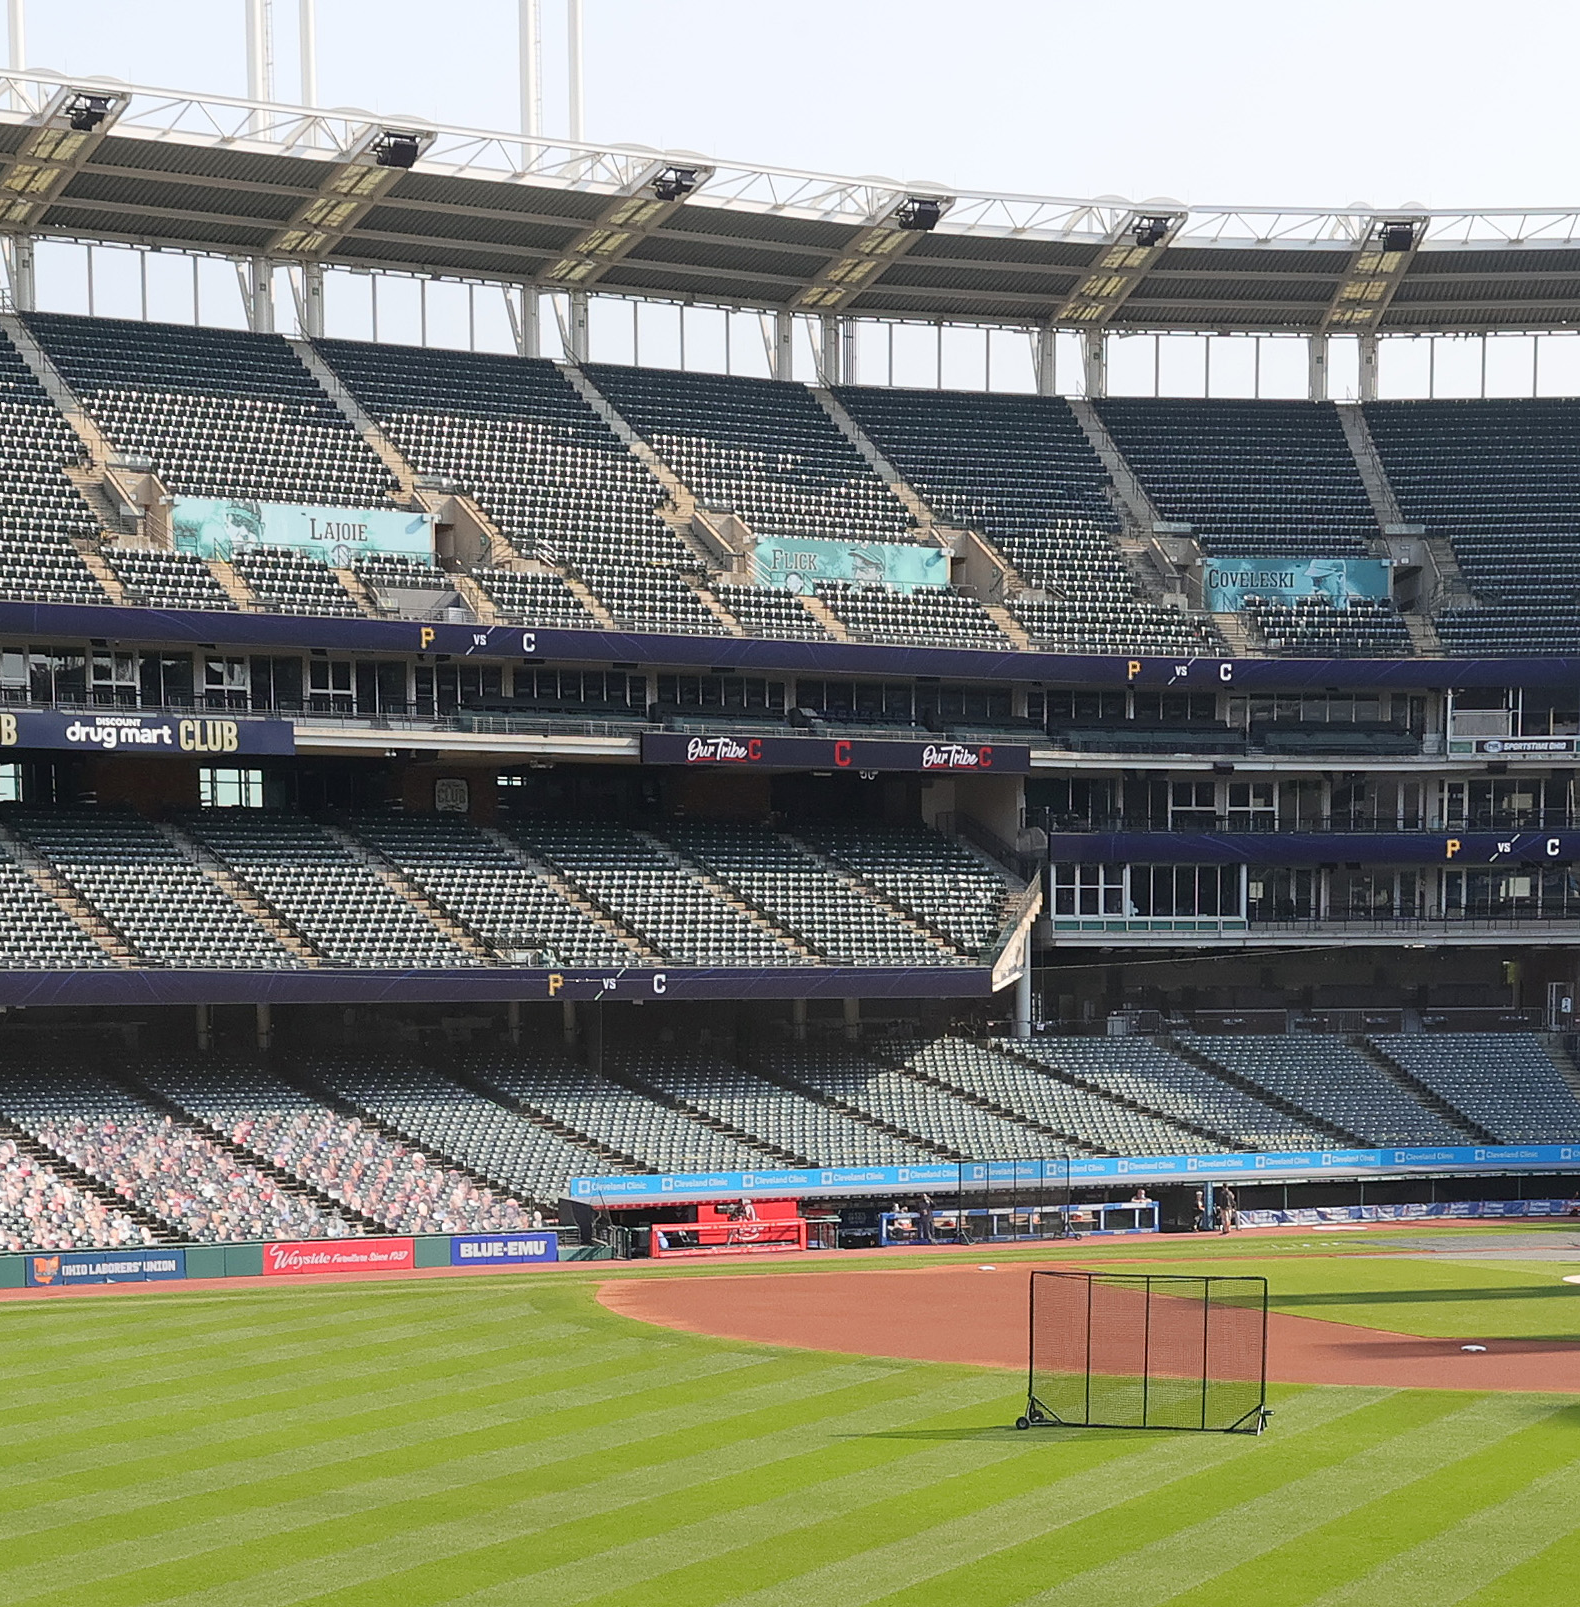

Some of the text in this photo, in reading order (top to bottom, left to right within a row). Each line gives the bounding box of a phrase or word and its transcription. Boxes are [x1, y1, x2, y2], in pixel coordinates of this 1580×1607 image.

[420, 627, 436, 649] P
[523, 632, 537, 652] C
[1128, 660, 1141, 680] P
[1220, 663, 1232, 681] C
[95, 716, 142, 727] DISCOUNT
[65, 719, 239, 753] drug mart CLUB
[687, 737, 762, 761] Our Tribe C
[834, 740, 853, 767] C
[923, 744, 993, 768] Our Tribe C
[1446, 840, 1460, 859] P
[1547, 839, 1560, 857] C
[547, 973, 565, 997] P
[653, 974, 667, 994] C
[270, 1243, 331, 1271] Wayside
[459, 1239, 547, 1259] BLUE-EMU
[88, 1261, 142, 1275] LABORERS'
[143, 1259, 176, 1273] UNION
